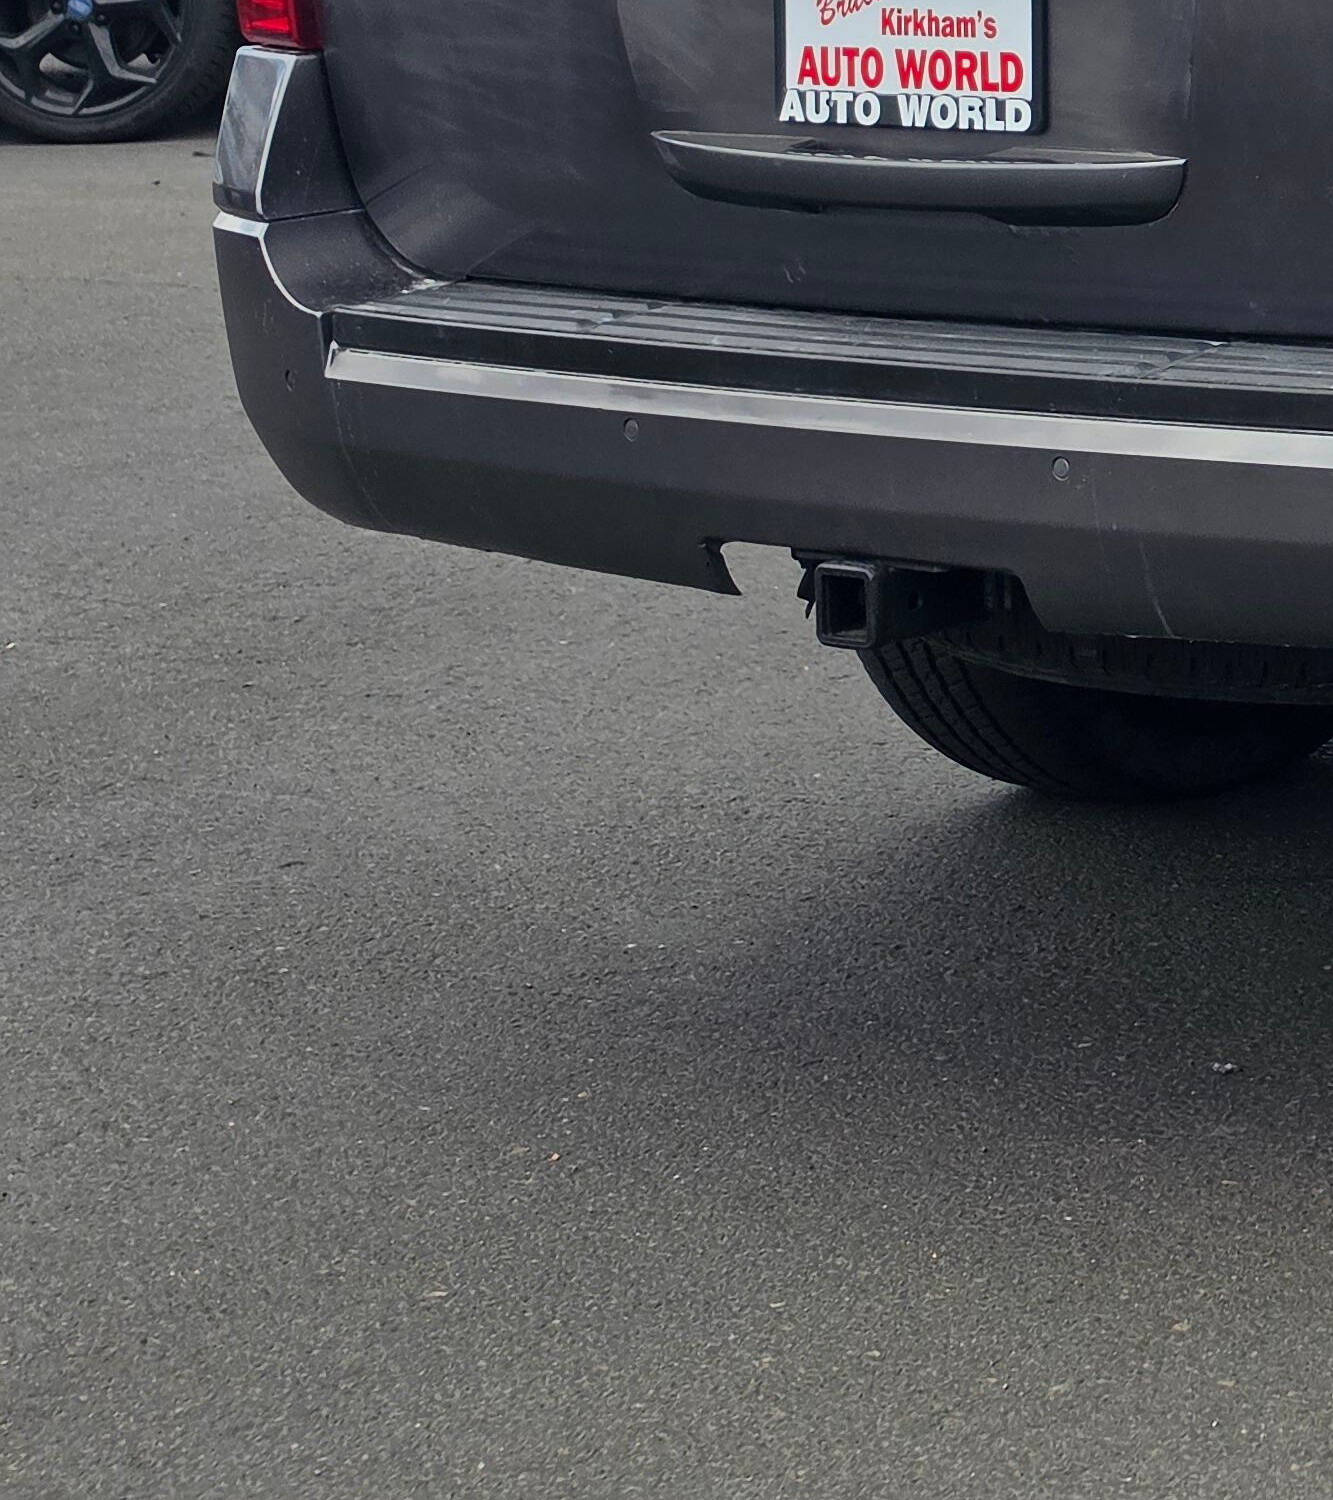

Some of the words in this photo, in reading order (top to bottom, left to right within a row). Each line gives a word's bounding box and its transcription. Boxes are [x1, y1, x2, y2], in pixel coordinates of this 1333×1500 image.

[881, 7, 997, 39] Kirkham's
[797, 45, 884, 88] AUTO
[895, 48, 1024, 93] WORLD
[779, 89, 881, 127] AUTO
[896, 93, 1032, 132] WORLD
